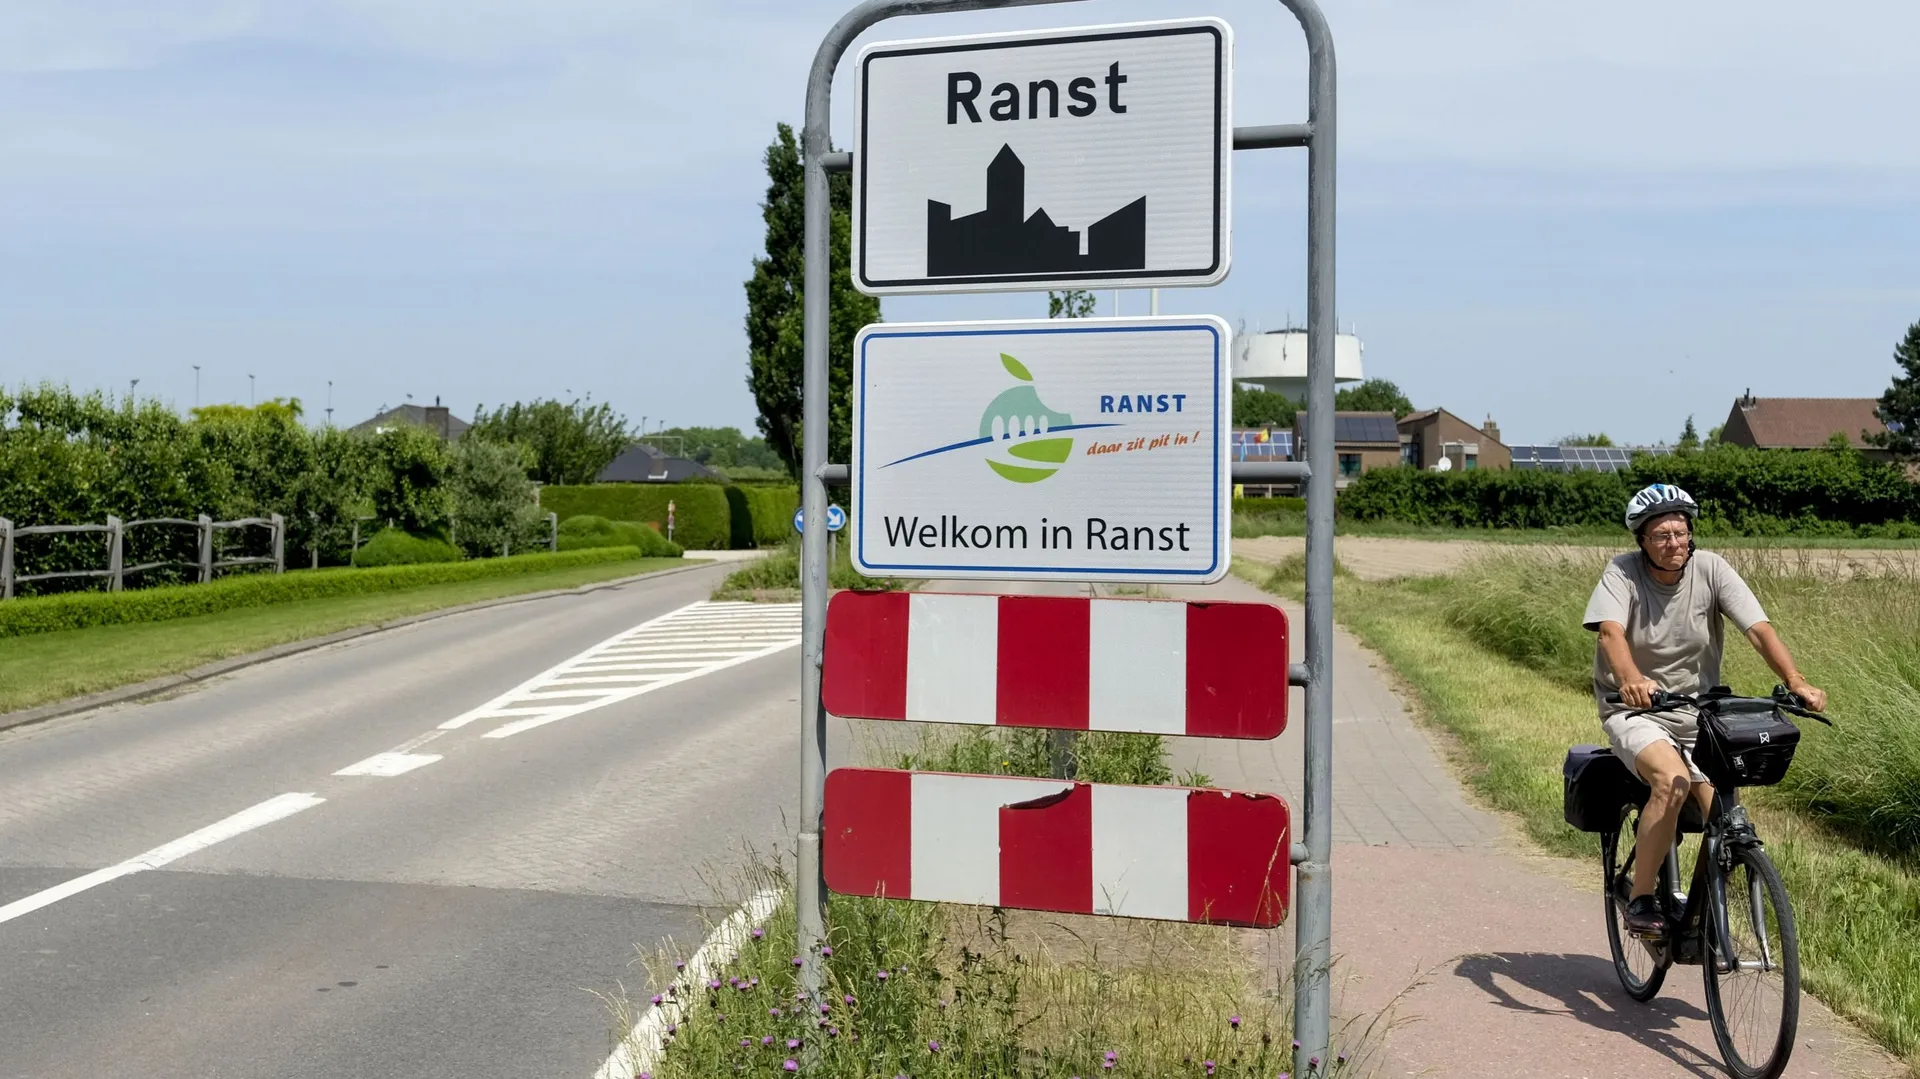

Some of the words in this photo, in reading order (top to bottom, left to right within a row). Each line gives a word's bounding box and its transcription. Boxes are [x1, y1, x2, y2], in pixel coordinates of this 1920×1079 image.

[947, 60, 1128, 125] Ranst
[1100, 394, 1186, 413] RANST
[1087, 441, 1123, 456] daar
[1126, 437, 1146, 452] zit
[1148, 434, 1171, 452] pit
[884, 515, 1028, 549] Welkom
[1041, 518, 1073, 550] in
[1086, 518, 1190, 552] Ranst
